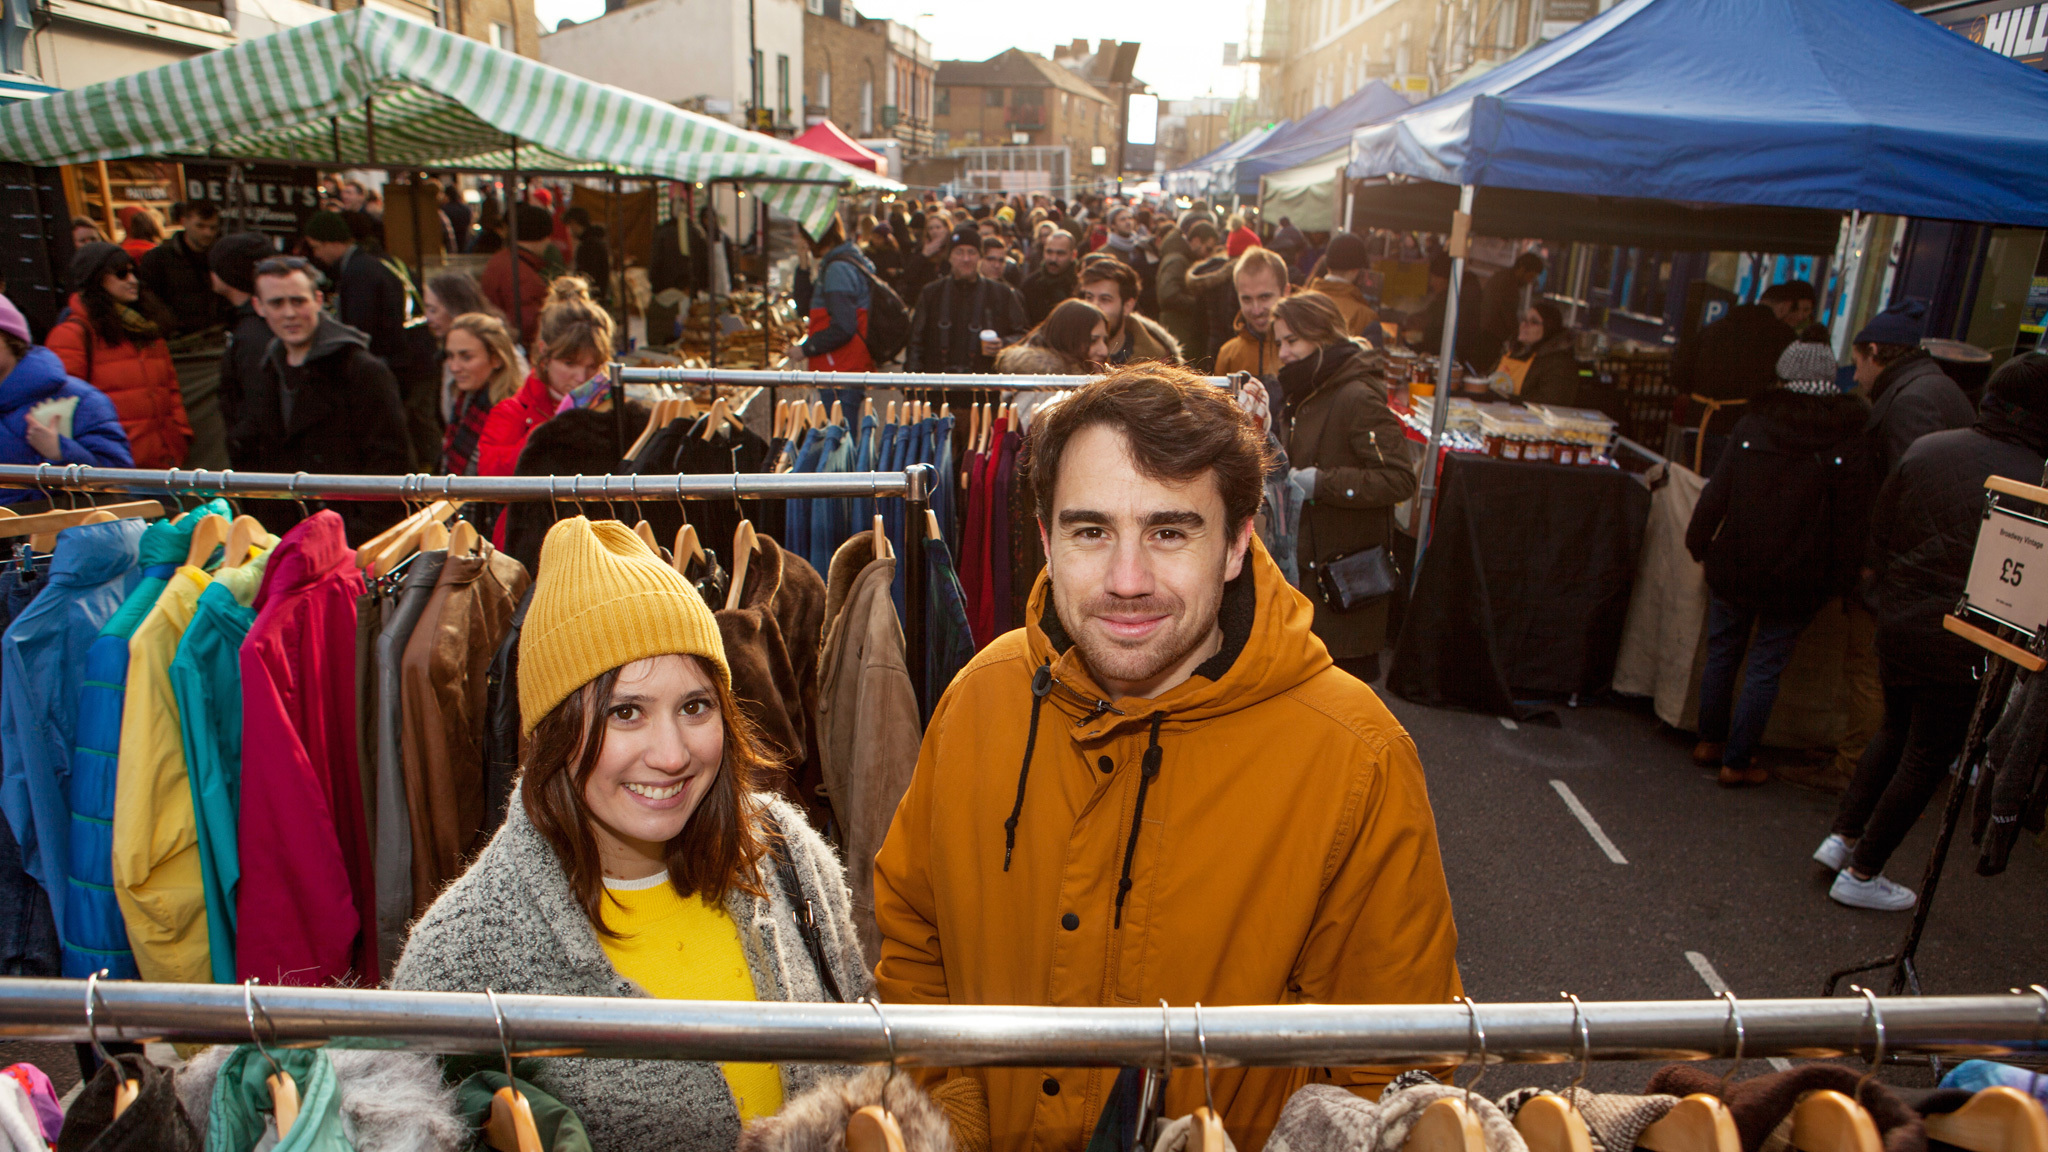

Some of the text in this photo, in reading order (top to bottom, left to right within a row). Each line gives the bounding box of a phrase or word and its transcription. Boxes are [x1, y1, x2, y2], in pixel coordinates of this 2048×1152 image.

[1706, 300, 1723, 323] P
[1999, 528, 2044, 550] Broadway Vintage
[1999, 557, 2025, 587] £5
